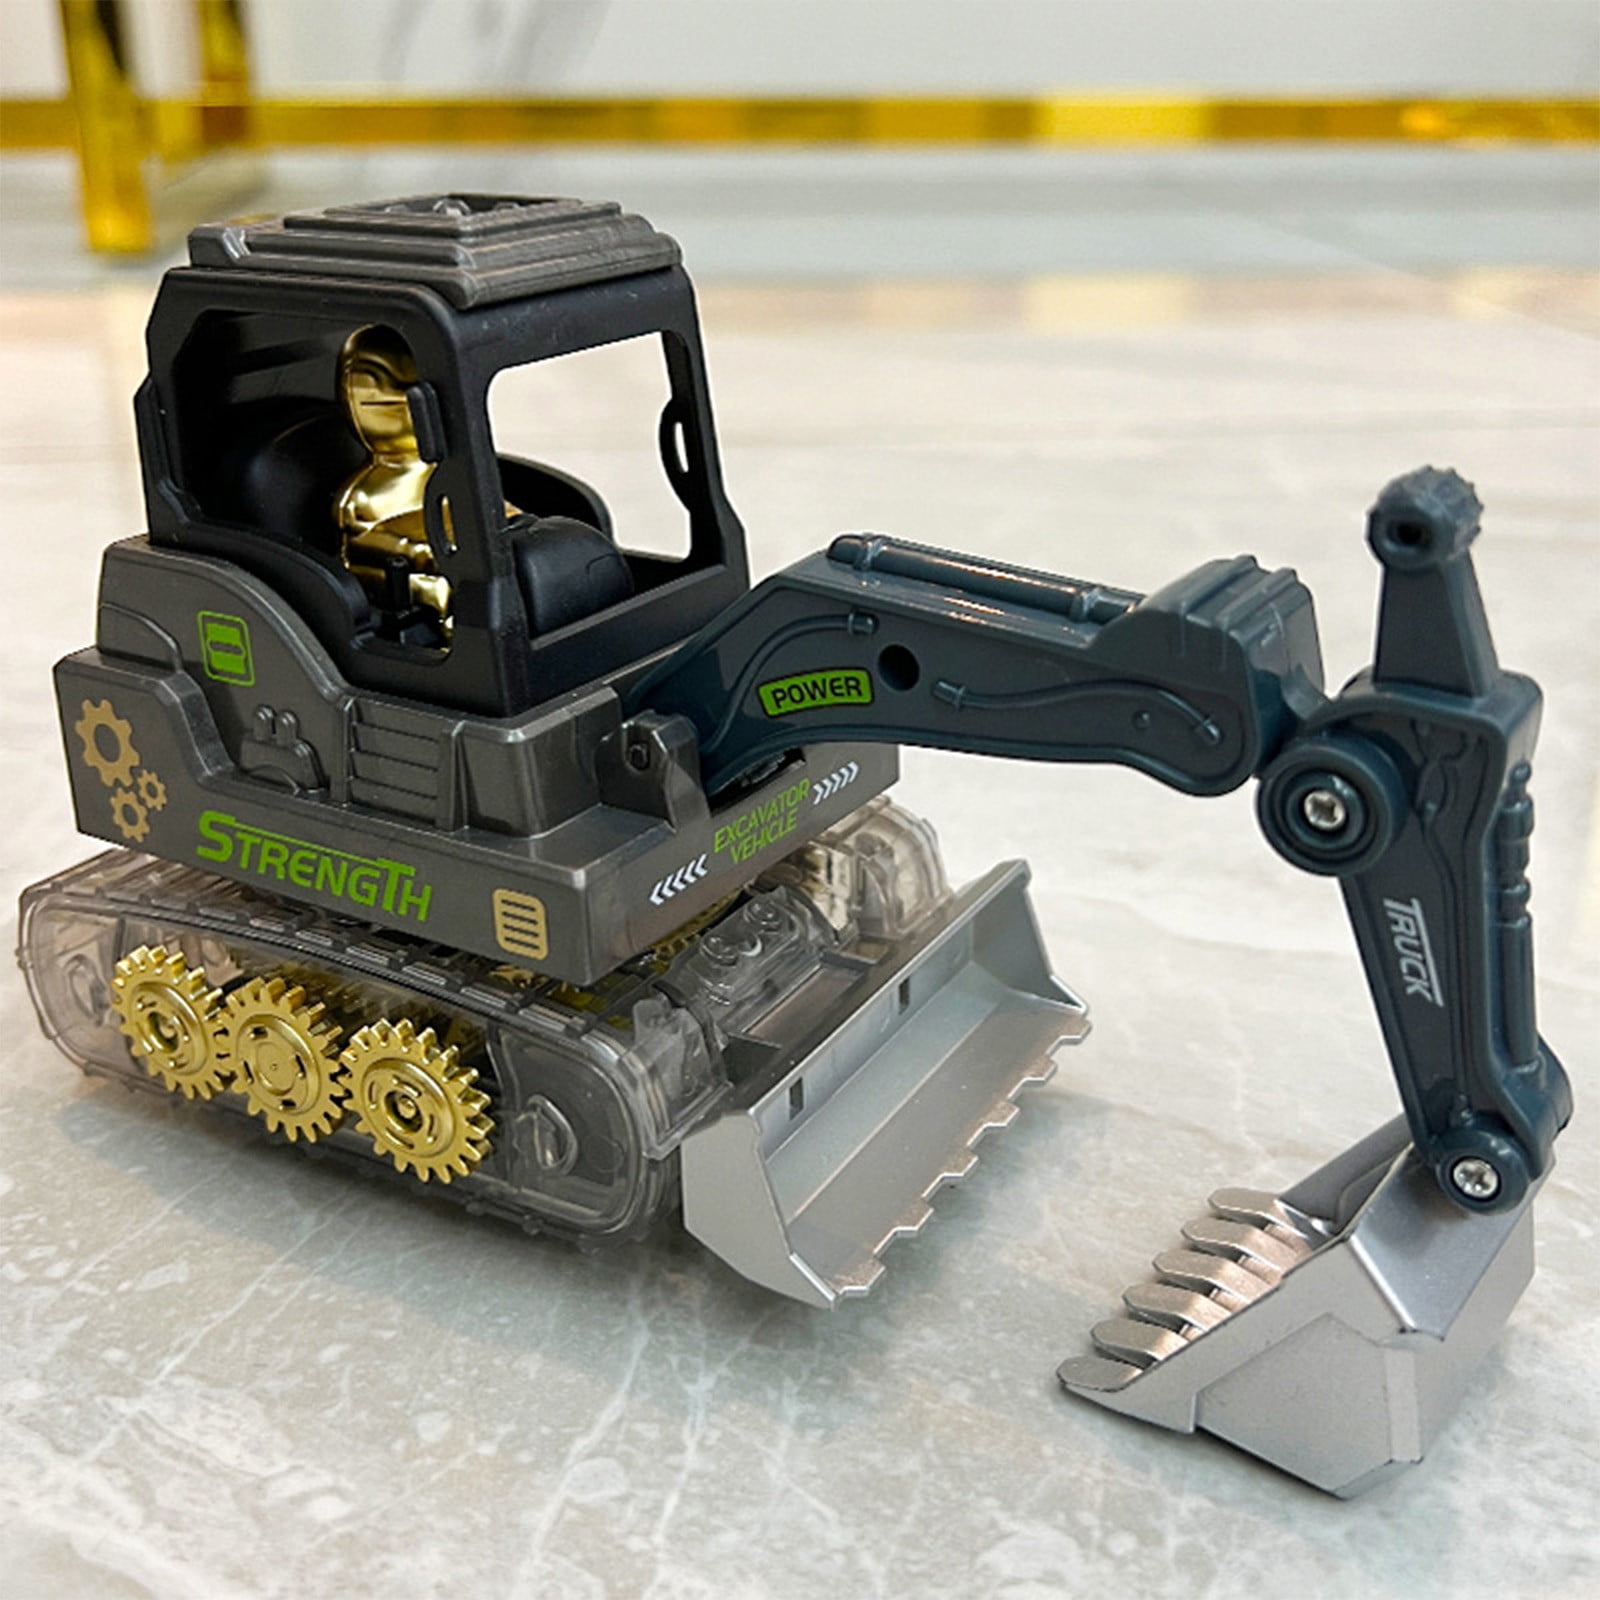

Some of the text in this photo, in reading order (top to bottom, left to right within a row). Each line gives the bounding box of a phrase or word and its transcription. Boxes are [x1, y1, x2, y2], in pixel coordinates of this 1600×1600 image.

[771, 676, 862, 709] POWER
[714, 778, 810, 853] EXCAVATOR
[730, 808, 798, 864] VEHICLE
[197, 810, 432, 921] STRENGTH
[1383, 898, 1444, 1007] TRUCK
